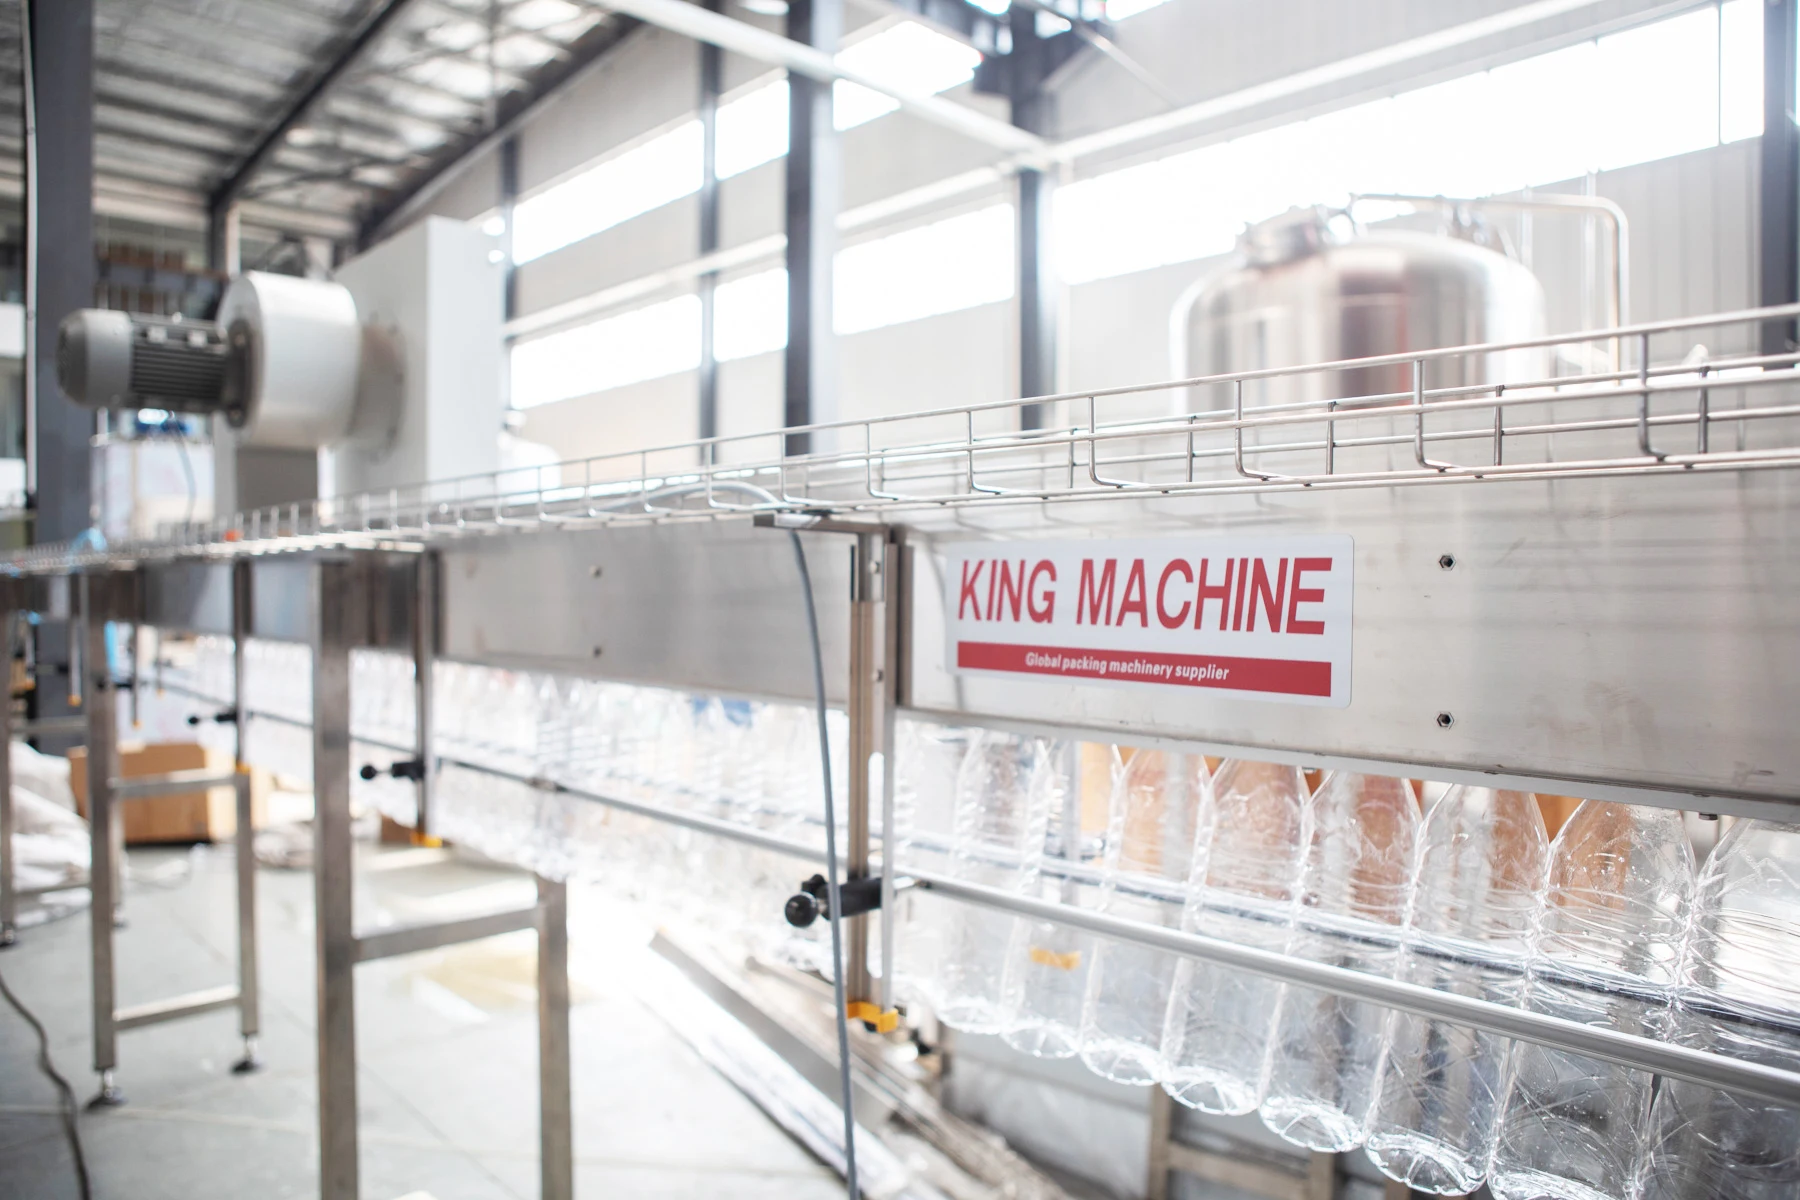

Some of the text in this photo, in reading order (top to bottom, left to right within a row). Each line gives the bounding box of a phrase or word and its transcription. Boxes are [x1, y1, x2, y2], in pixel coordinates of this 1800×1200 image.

[958, 557, 1333, 635] KING MACHINE
[1025, 651, 1230, 682] Global packing machinery supplier
